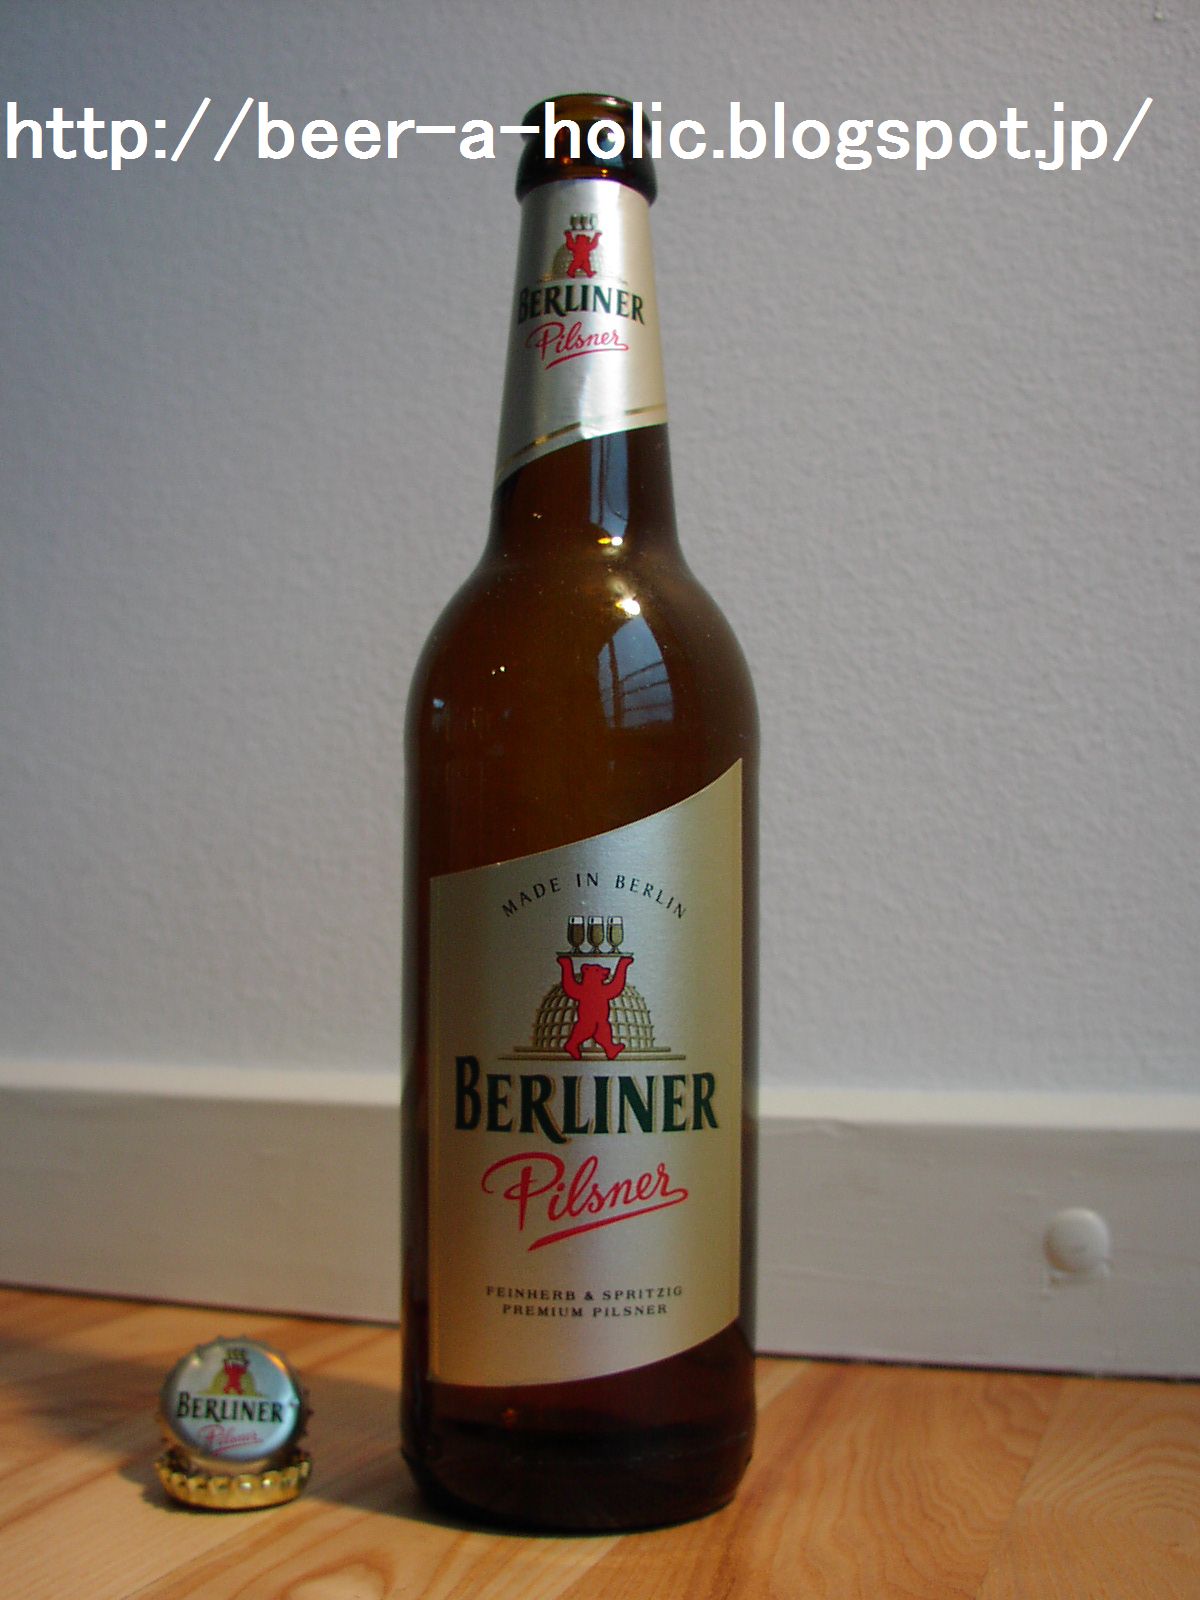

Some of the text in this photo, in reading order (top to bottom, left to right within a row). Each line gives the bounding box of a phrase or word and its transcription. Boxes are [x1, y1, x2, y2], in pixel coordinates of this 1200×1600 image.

[517, 284, 646, 326] BERLINER
[526, 320, 629, 371] Pilsner
[502, 872, 687, 920] MADE IN BERLIN
[454, 1055, 720, 1145] BERLINER
[481, 1152, 689, 1252] Pilsner
[486, 1284, 684, 1302] FEINHERB & SPRITZIG
[502, 1302, 668, 1319] PREMIUM PILSNER
[176, 1390, 284, 1423] BERLINER
